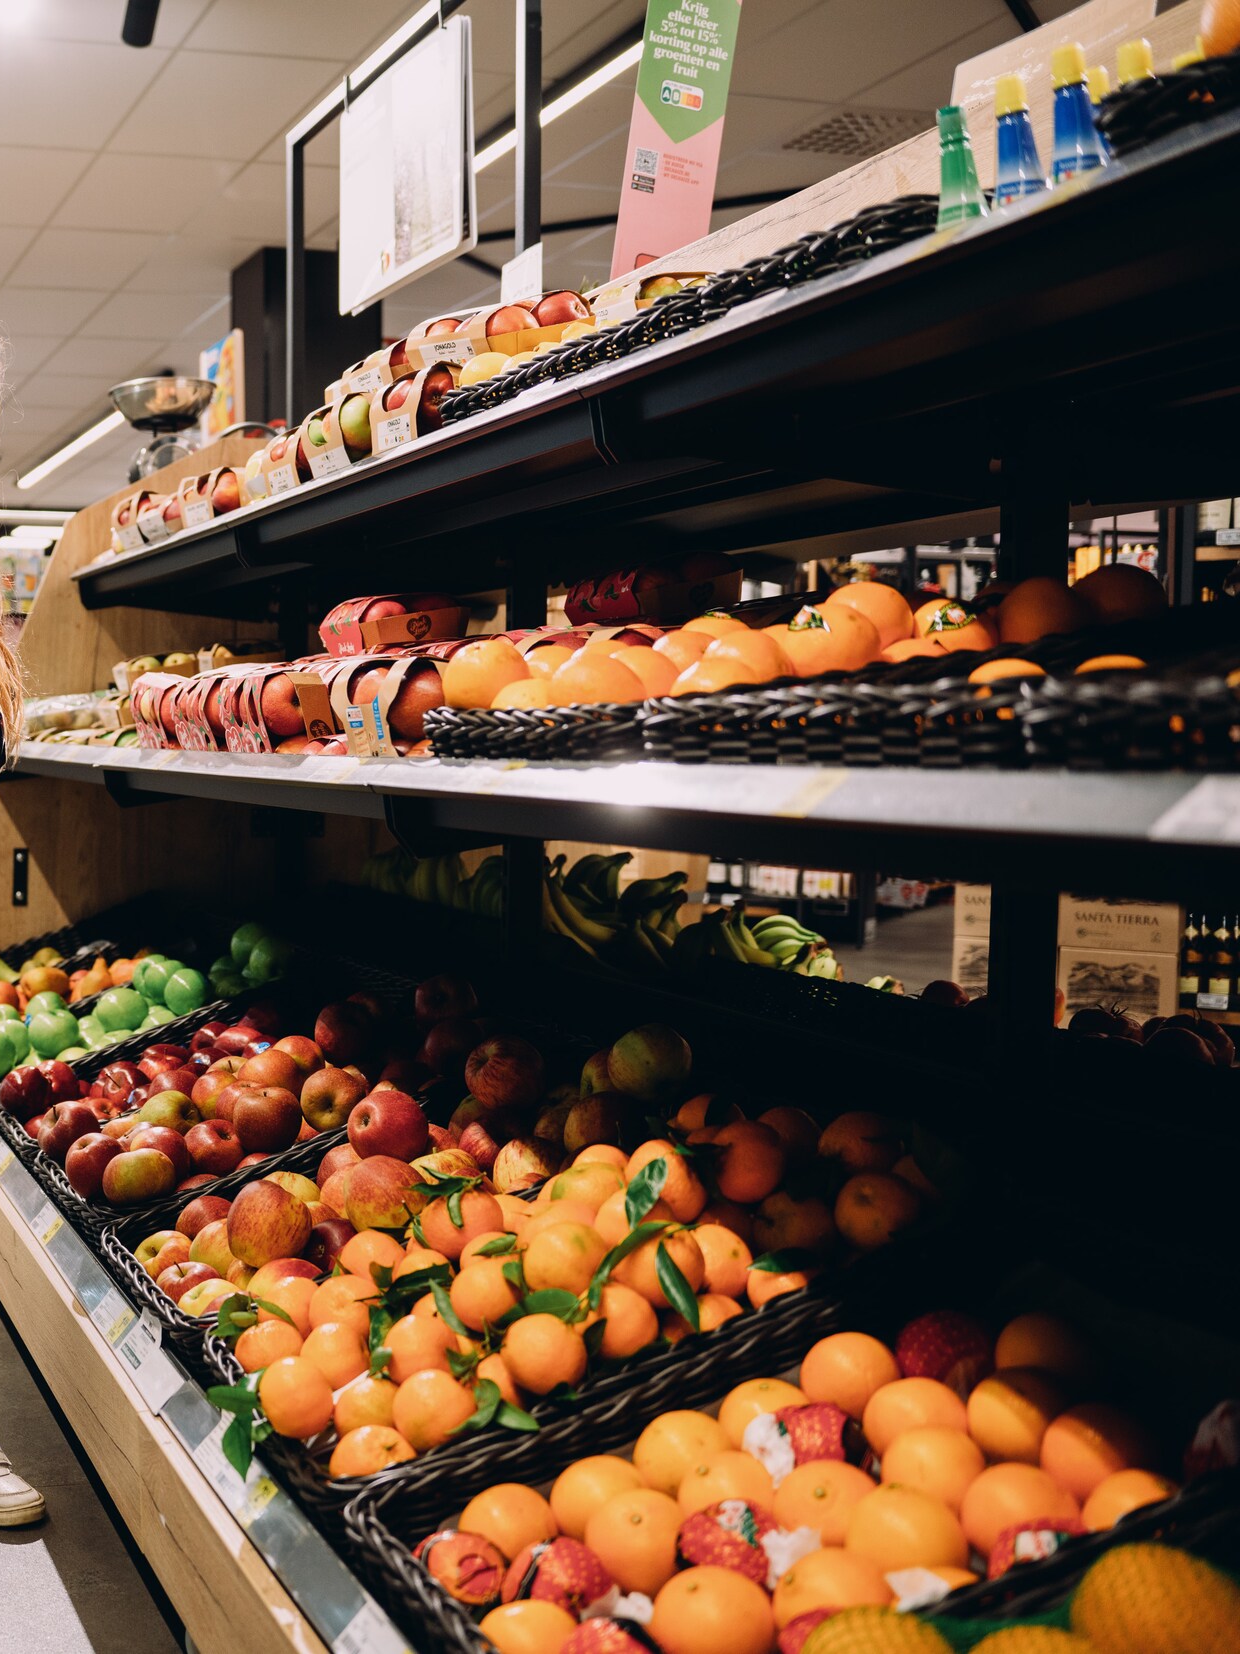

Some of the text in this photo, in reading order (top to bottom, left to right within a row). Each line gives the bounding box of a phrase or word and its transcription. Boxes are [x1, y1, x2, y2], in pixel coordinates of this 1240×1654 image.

[681, 0, 709, 18] Krijg
[661, 20, 678, 34] 5%
[680, 26, 695, 38] tot
[668, 10, 718, 31] elke keer
[649, 30, 728, 60] korting op alle
[653, 47, 720, 71] groenten en
[673, 62, 699, 78] fruit
[1075, 911, 1159, 926] SANTA TIERRA
